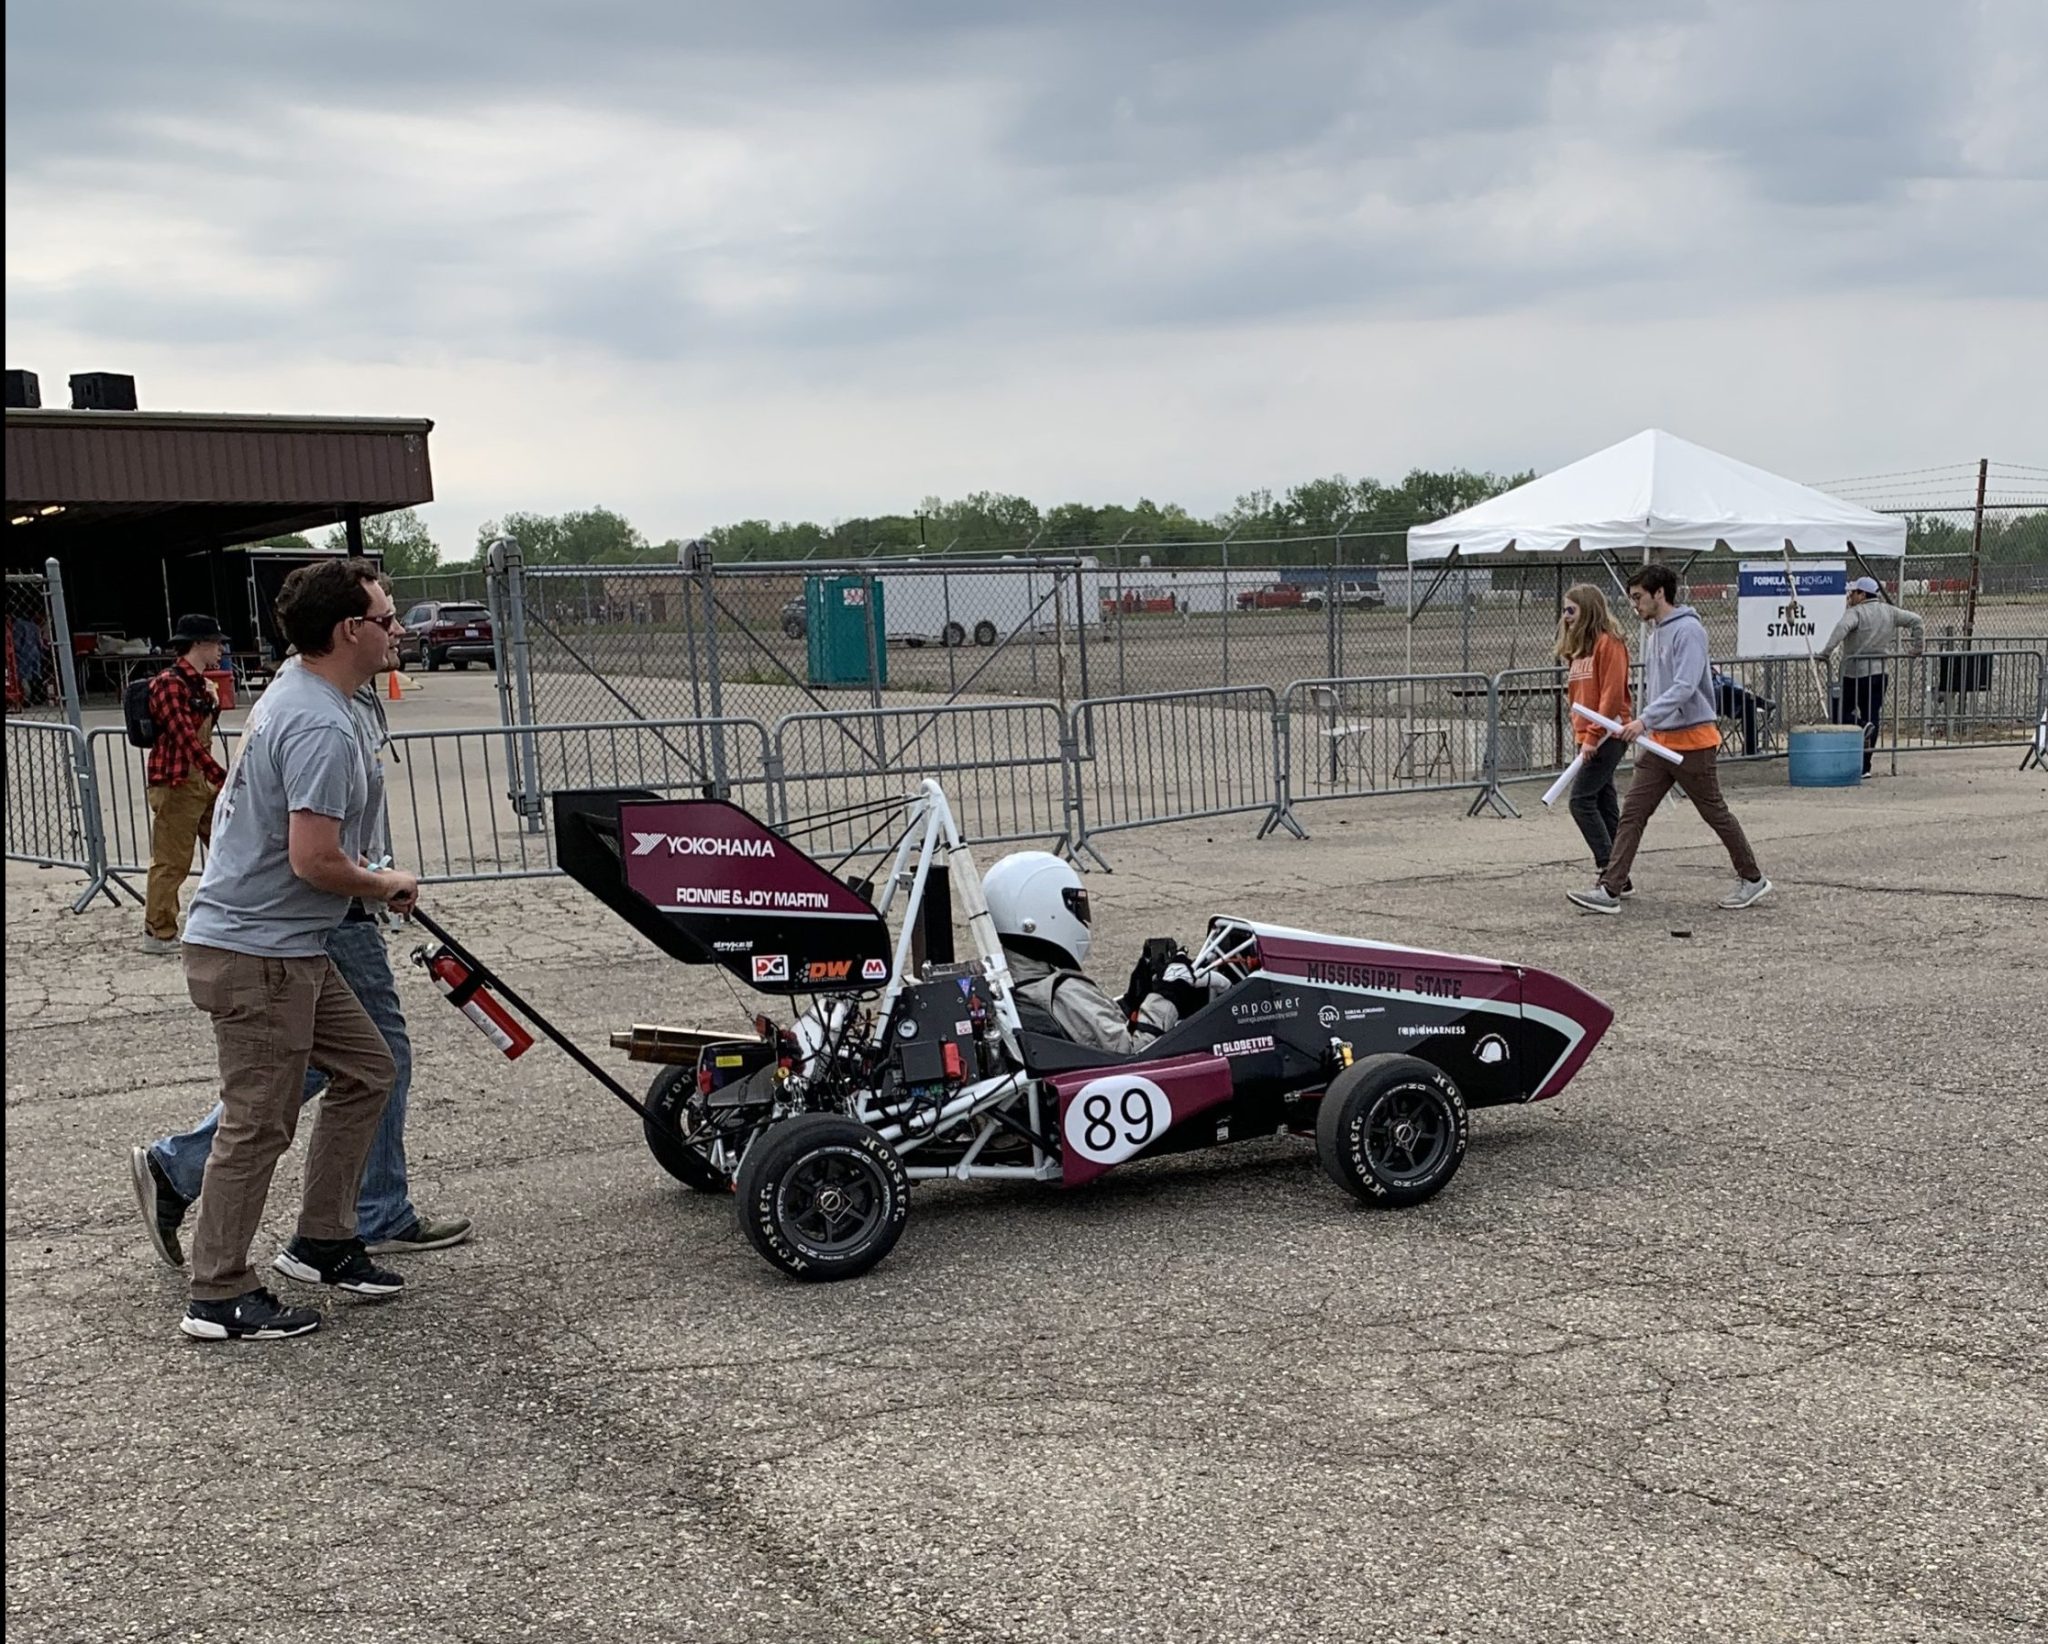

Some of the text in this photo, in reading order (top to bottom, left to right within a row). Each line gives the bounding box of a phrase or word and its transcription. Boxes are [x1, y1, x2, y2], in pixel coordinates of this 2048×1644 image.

[1752, 576, 1786, 586] FORMULA
[1778, 604, 1807, 619] FEL
[1767, 622, 1815, 637] STATION
[666, 836, 775, 858] YOKOHAMA
[676, 887, 829, 908] RONNIE & JOY MARTIN
[809, 960, 852, 978] DW
[1307, 962, 1462, 1000] MISSISSIPPI STATE
[1083, 1088, 1154, 1151] 89
